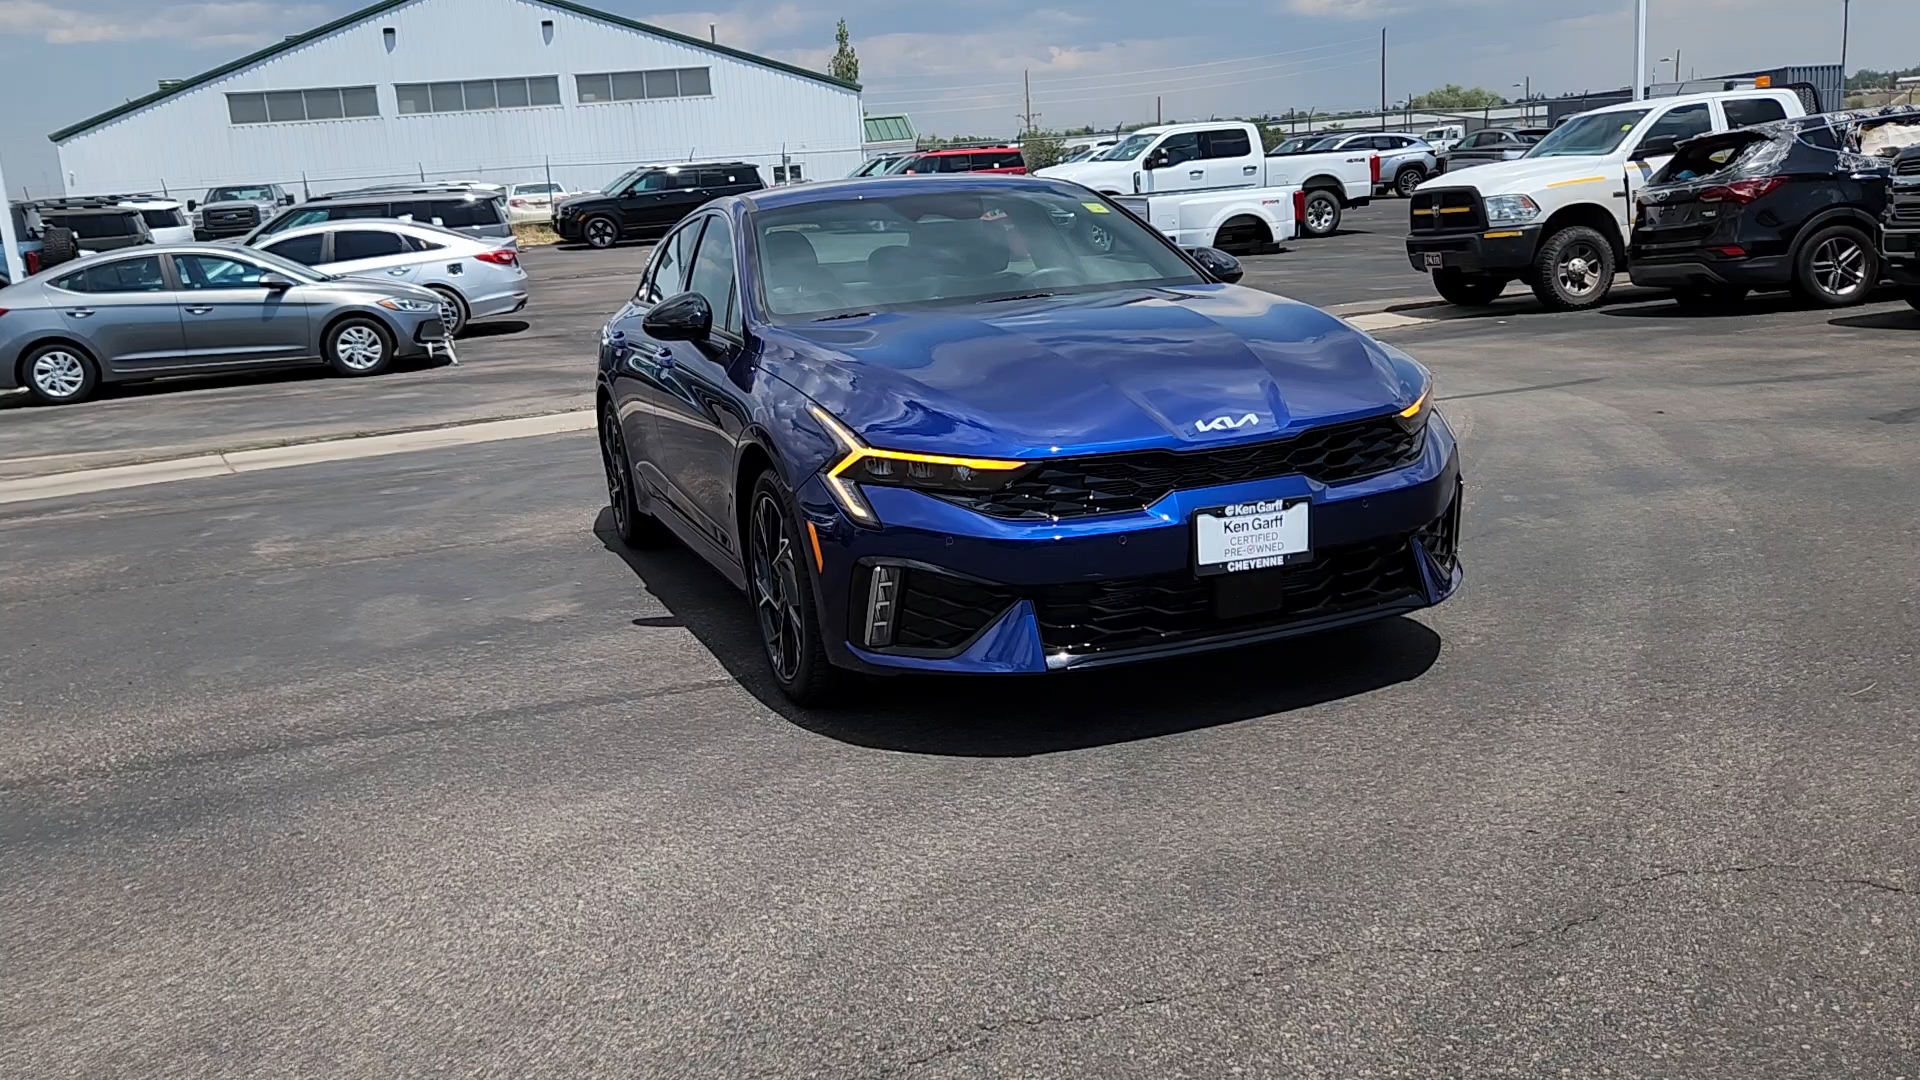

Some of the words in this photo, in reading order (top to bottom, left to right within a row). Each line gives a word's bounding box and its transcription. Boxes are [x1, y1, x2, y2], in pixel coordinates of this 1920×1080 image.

[1195, 413, 1259, 432] KIA
[1235, 503, 1256, 516] Ken
[1256, 499, 1284, 512] Garff
[1224, 520, 1250, 534] Ken
[1251, 515, 1284, 531] Garff
[1229, 531, 1279, 546] CERTIFIED
[1227, 556, 1284, 572] CHEYENNE
